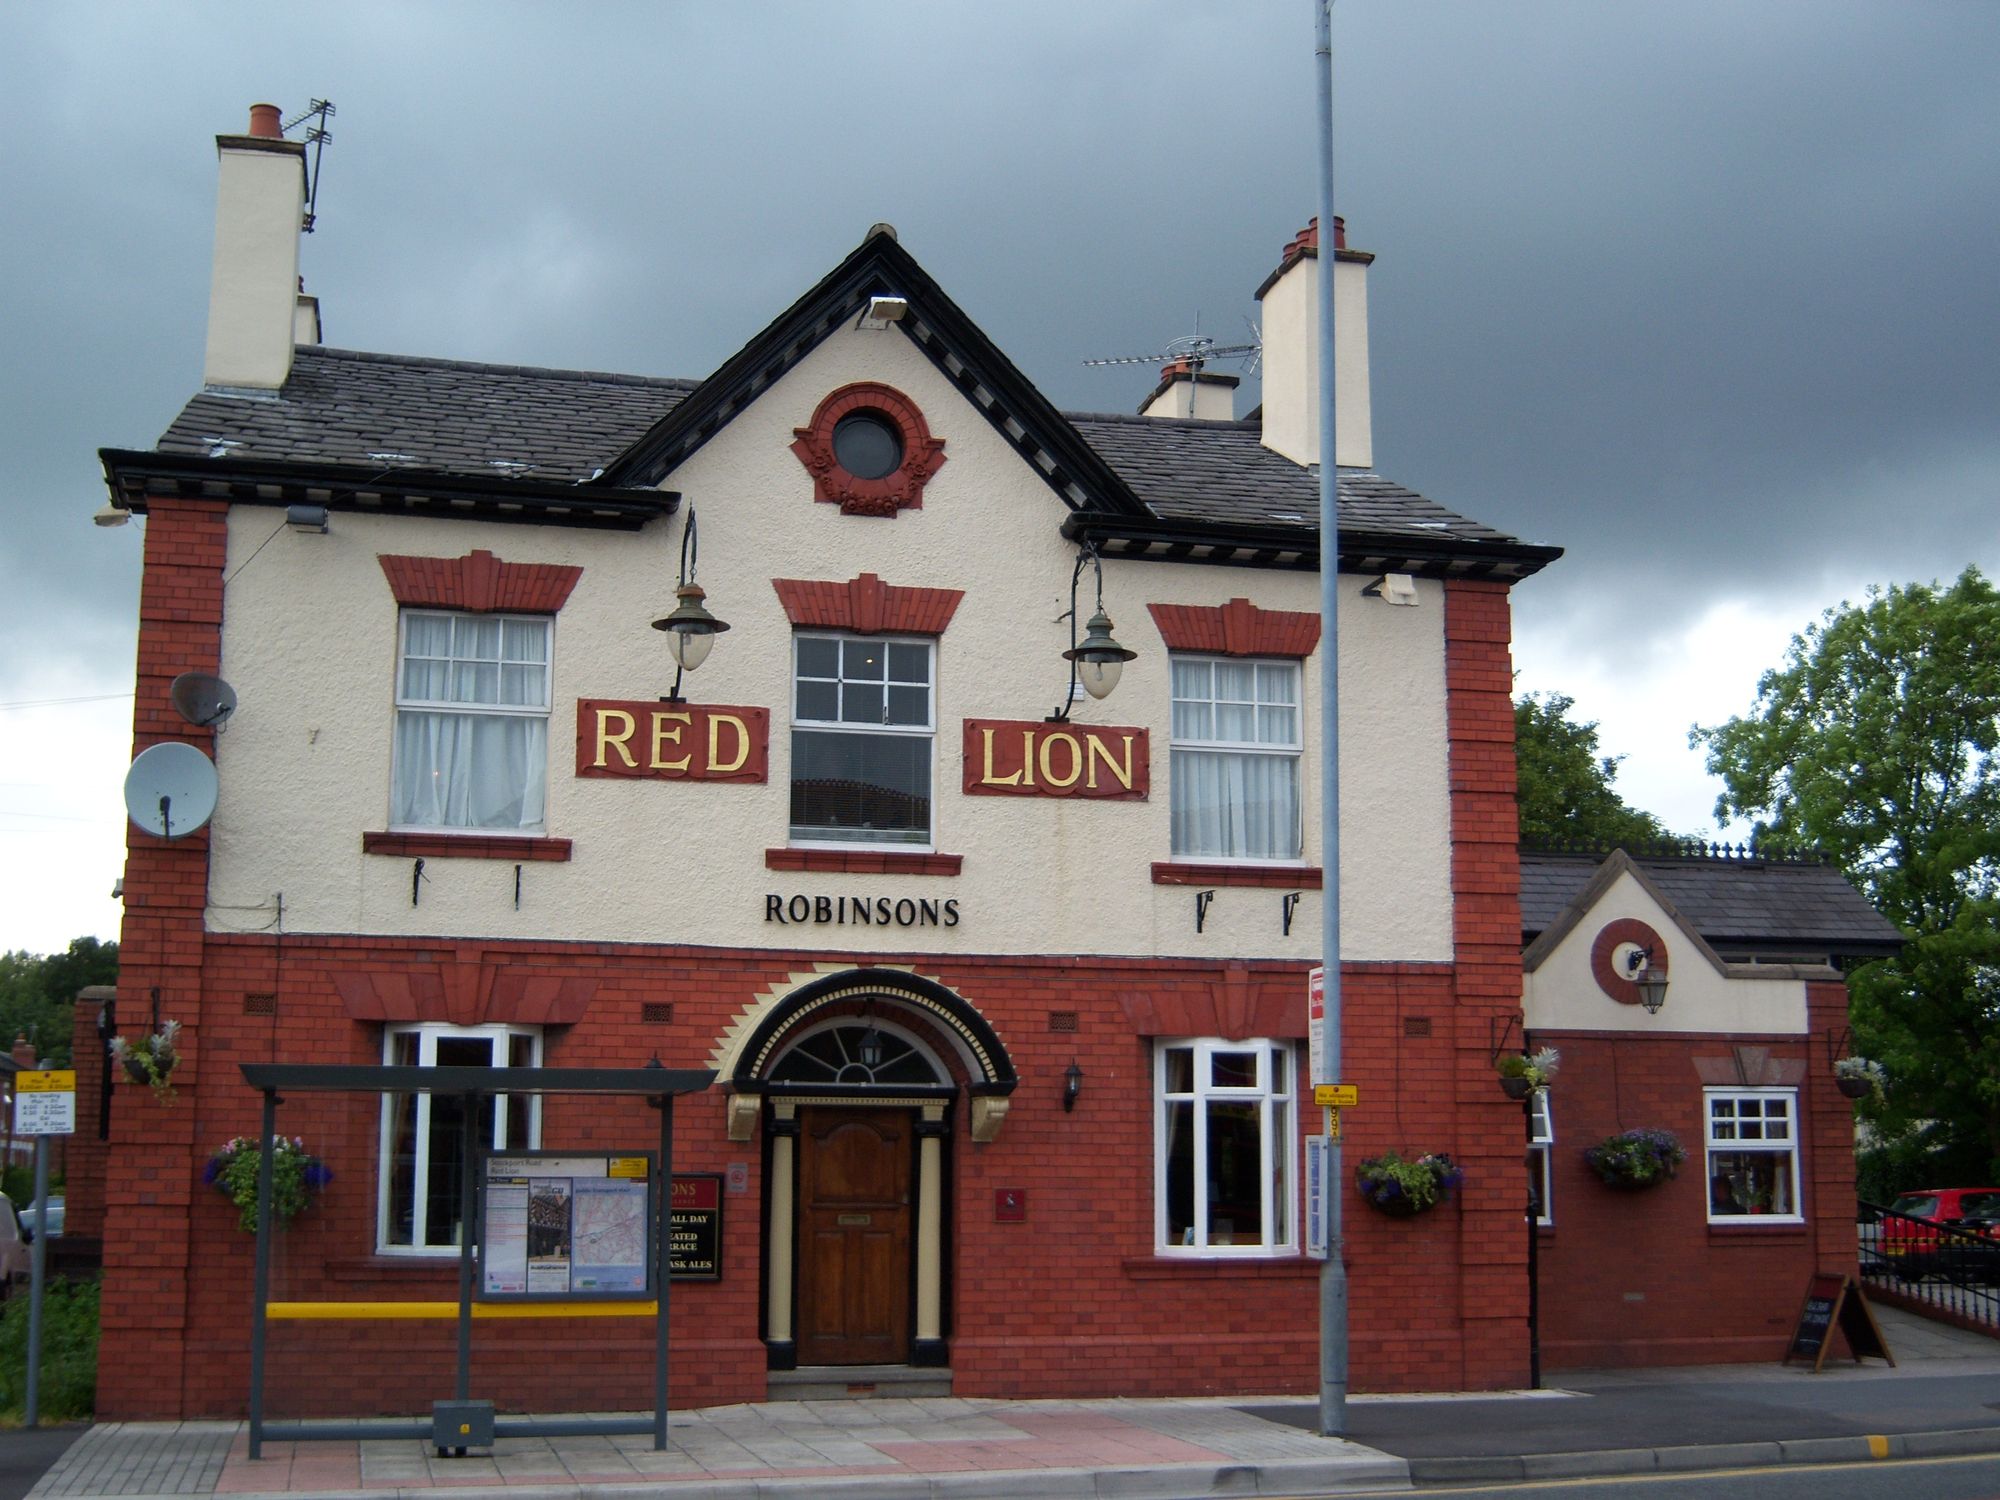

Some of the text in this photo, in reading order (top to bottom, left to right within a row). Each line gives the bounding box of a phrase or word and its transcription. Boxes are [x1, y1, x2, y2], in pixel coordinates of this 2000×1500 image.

[593, 708, 750, 773] RED
[981, 728, 1134, 790] LION
[765, 893, 961, 927] ROBINSONS
[671, 1215, 708, 1223] ALL DAY
[670, 1232, 698, 1240] EATED
[670, 1260, 712, 1269] ASK ALES
